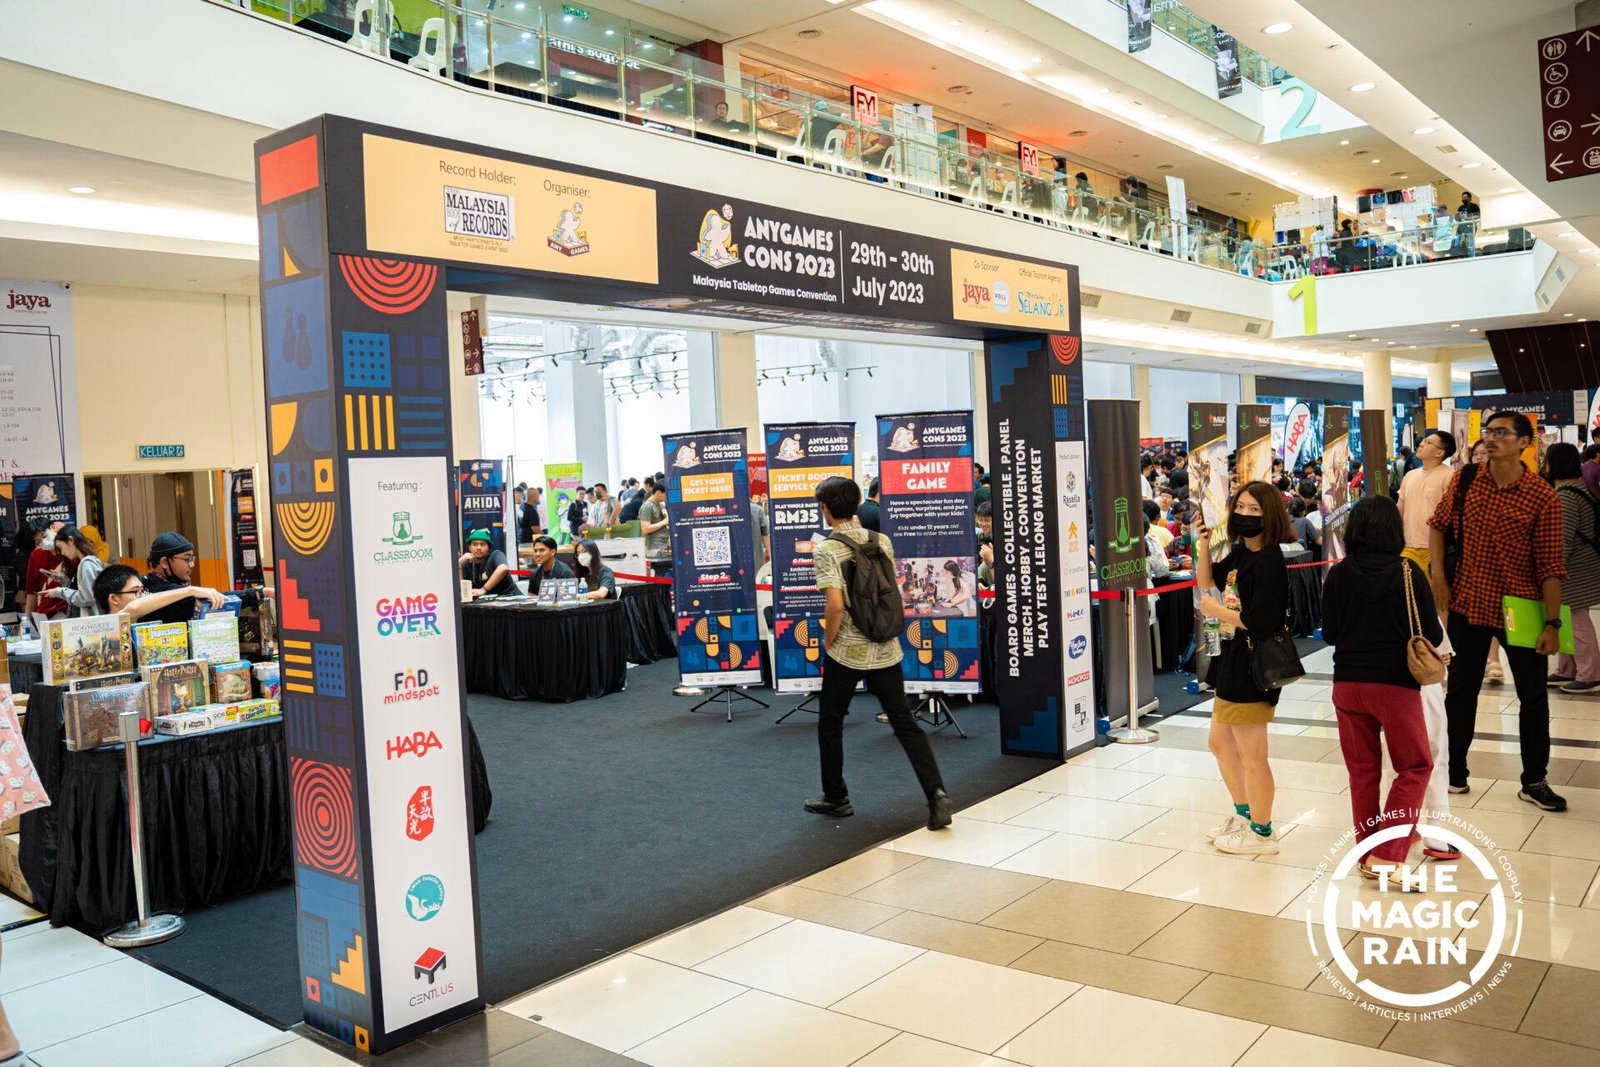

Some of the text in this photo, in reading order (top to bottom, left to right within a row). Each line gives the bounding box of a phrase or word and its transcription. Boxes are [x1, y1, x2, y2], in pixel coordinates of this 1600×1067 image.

[1280, 76, 1320, 140] 2
[439, 160, 517, 186] Record Holder:
[543, 180, 591, 198] Organiser:
[446, 192, 507, 217] MALAYSIA
[462, 212, 508, 238] RECORDS
[743, 216, 834, 253] ANYGAMES
[550, 242, 562, 253] ANY
[570, 245, 589, 256] GAMES
[744, 244, 836, 279] CONS 2023
[850, 241, 886, 268] 29th
[900, 251, 935, 277] 30th
[692, 274, 837, 303] Malaysia Tabletop Games Convention
[852, 275, 924, 306] July 2023
[962, 278, 990, 305] jaya
[6, 289, 52, 310] jaya
[1288, 275, 1318, 336] 1
[923, 426, 966, 434] ANYGAMES
[946, 434, 966, 442] 2023
[1286, 413, 1308, 454] HABA
[703, 444, 740, 452] ANYGAMES
[808, 437, 848, 445] ANYGAMES
[140, 446, 175, 458] KELUAR
[902, 462, 952, 475] FAMILY
[378, 481, 418, 492] Featuring
[684, 487, 709, 495] TICKET
[690, 478, 704, 486] GET
[774, 483, 808, 492] SERVICE
[906, 478, 947, 490] GAME
[26, 505, 69, 515] ANYGAMES
[696, 506, 715, 514] Step
[775, 509, 819, 524] RM35
[374, 548, 433, 562] CLASSROOM
[1000, 418, 1020, 677] BOARD GAMES COLLECTIBLE PANEL
[1015, 439, 1034, 657] MERCH HOBBY CONVENTION
[1030, 448, 1049, 649] PLAY TEST LELONG MARKET
[700, 572, 728, 582] Step 2.
[376, 593, 438, 618] GAME
[377, 612, 441, 638] OVER
[384, 685, 440, 705] mindspot
[386, 730, 443, 761] HABA
[409, 982, 454, 1008] CENTLUS
